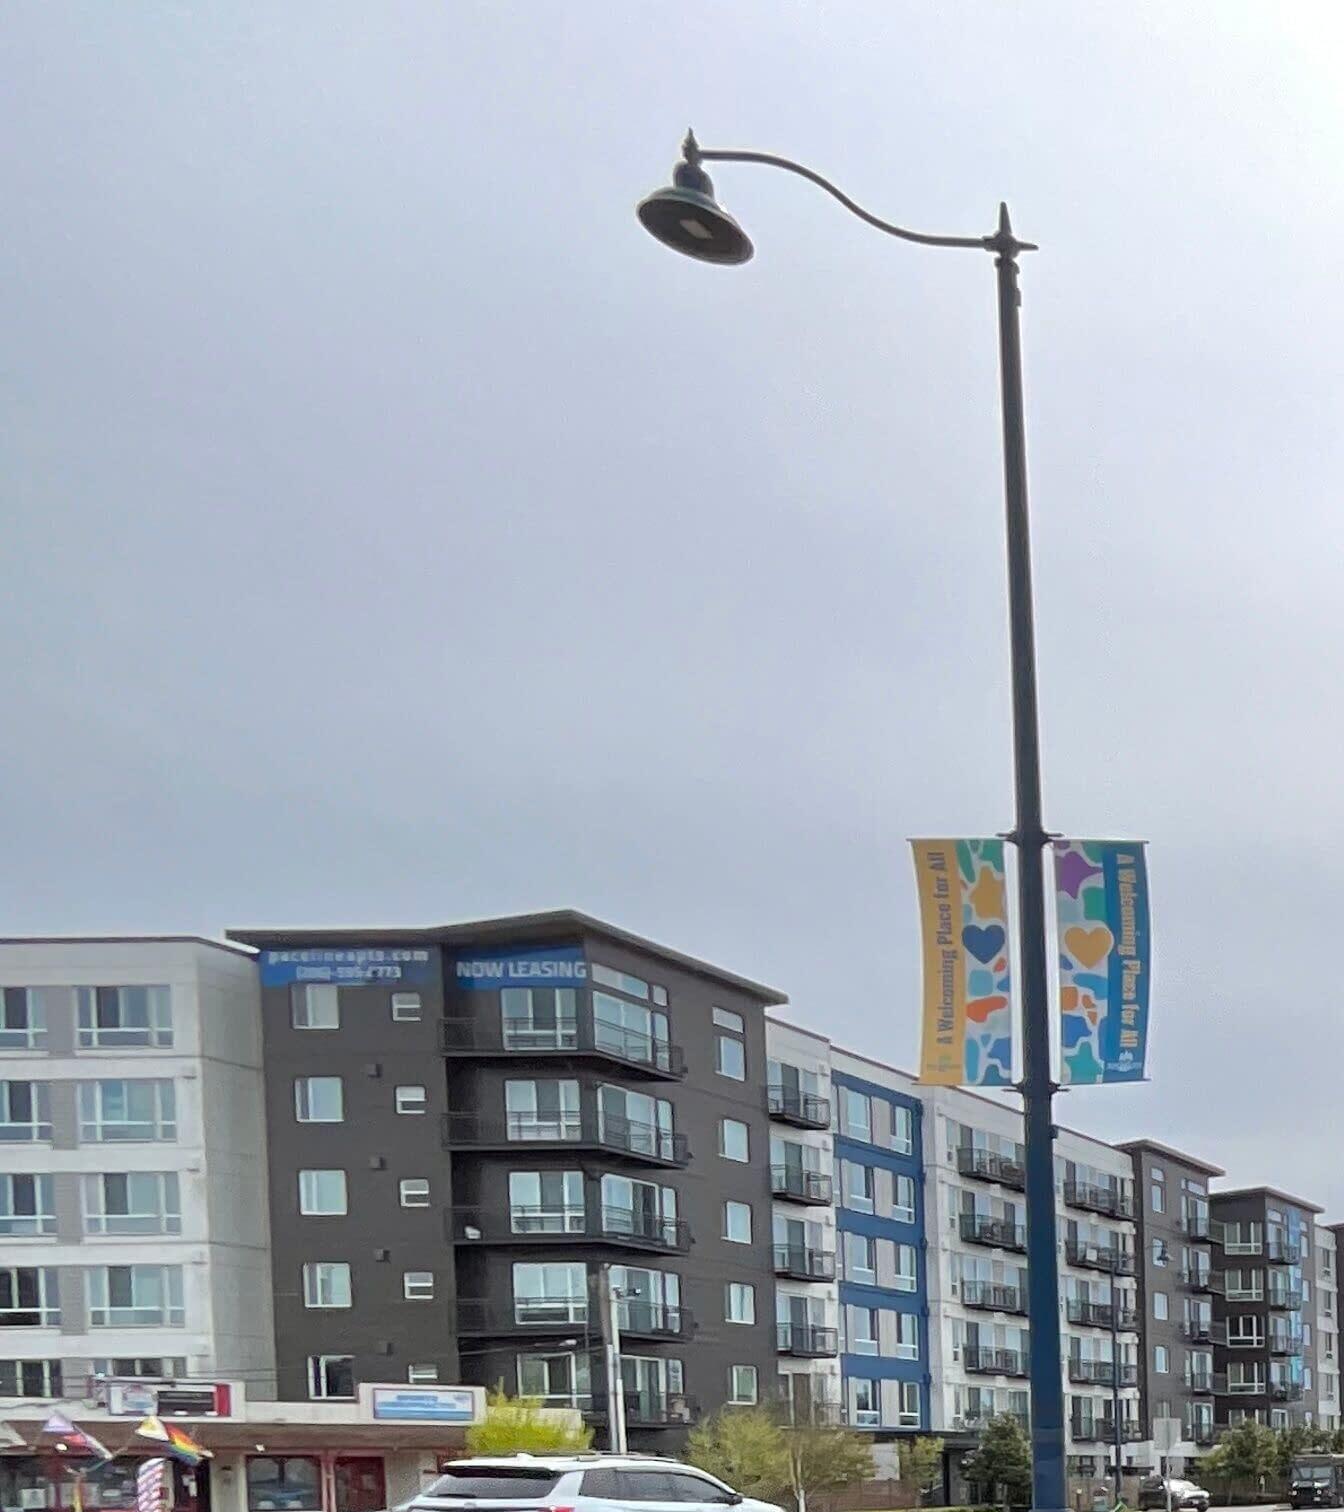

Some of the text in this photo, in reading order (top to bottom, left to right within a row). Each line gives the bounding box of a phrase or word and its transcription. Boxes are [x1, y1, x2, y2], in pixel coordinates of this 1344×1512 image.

[927, 851, 949, 872] All
[1115, 853, 1136, 865] A
[932, 876, 950, 899] for
[1117, 867, 1140, 956] Welcoming
[934, 902, 953, 946] Place
[456, 961, 587, 979] NOW LEASING
[1121, 958, 1142, 1001] Place
[936, 948, 958, 1033] Welcoming
[1120, 1003, 1141, 1026] for
[936, 1034, 953, 1045] A
[1119, 1028, 1139, 1048] All
